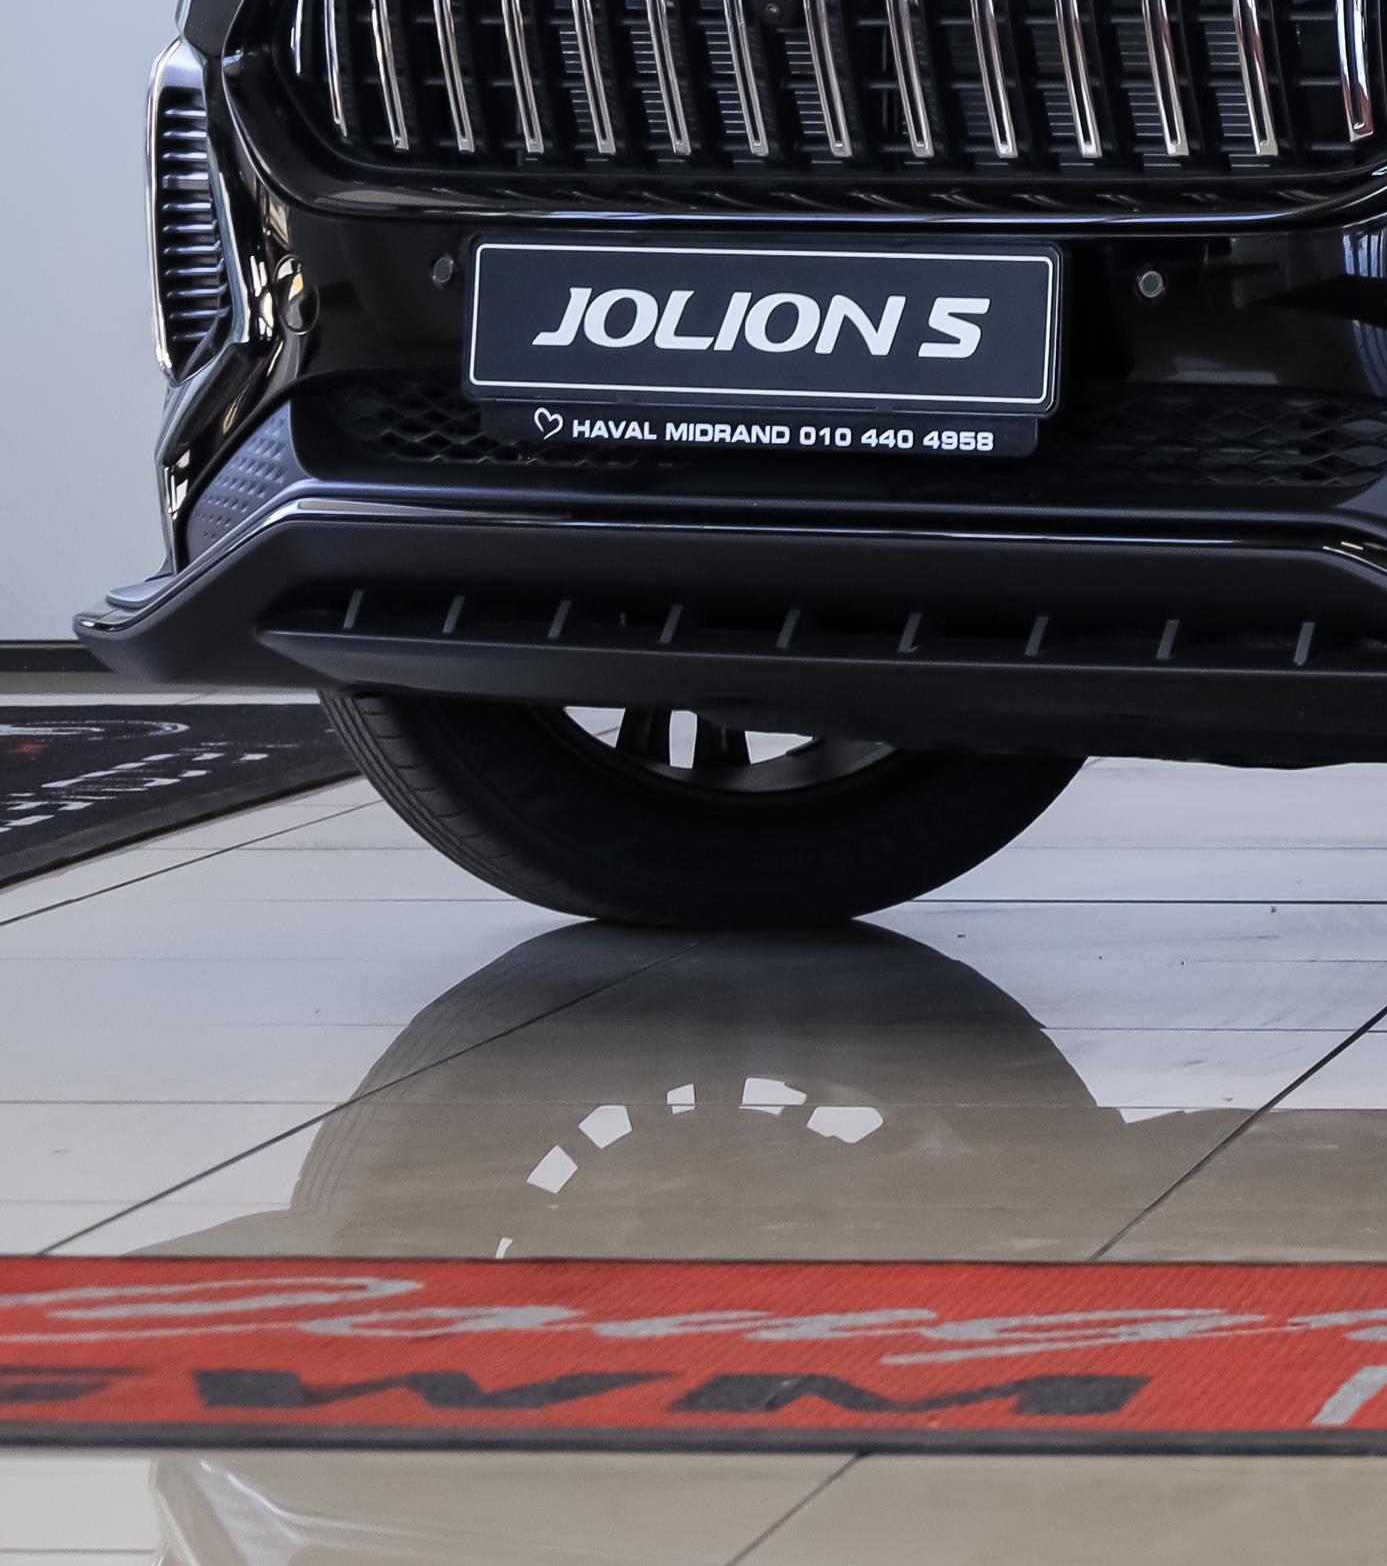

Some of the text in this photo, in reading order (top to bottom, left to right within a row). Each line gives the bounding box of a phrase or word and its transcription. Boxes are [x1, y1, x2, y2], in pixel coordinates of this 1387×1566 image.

[532, 287, 906, 356] JOLION
[572, 419, 994, 451] HAVAL MIDRAND 010 440 4958
